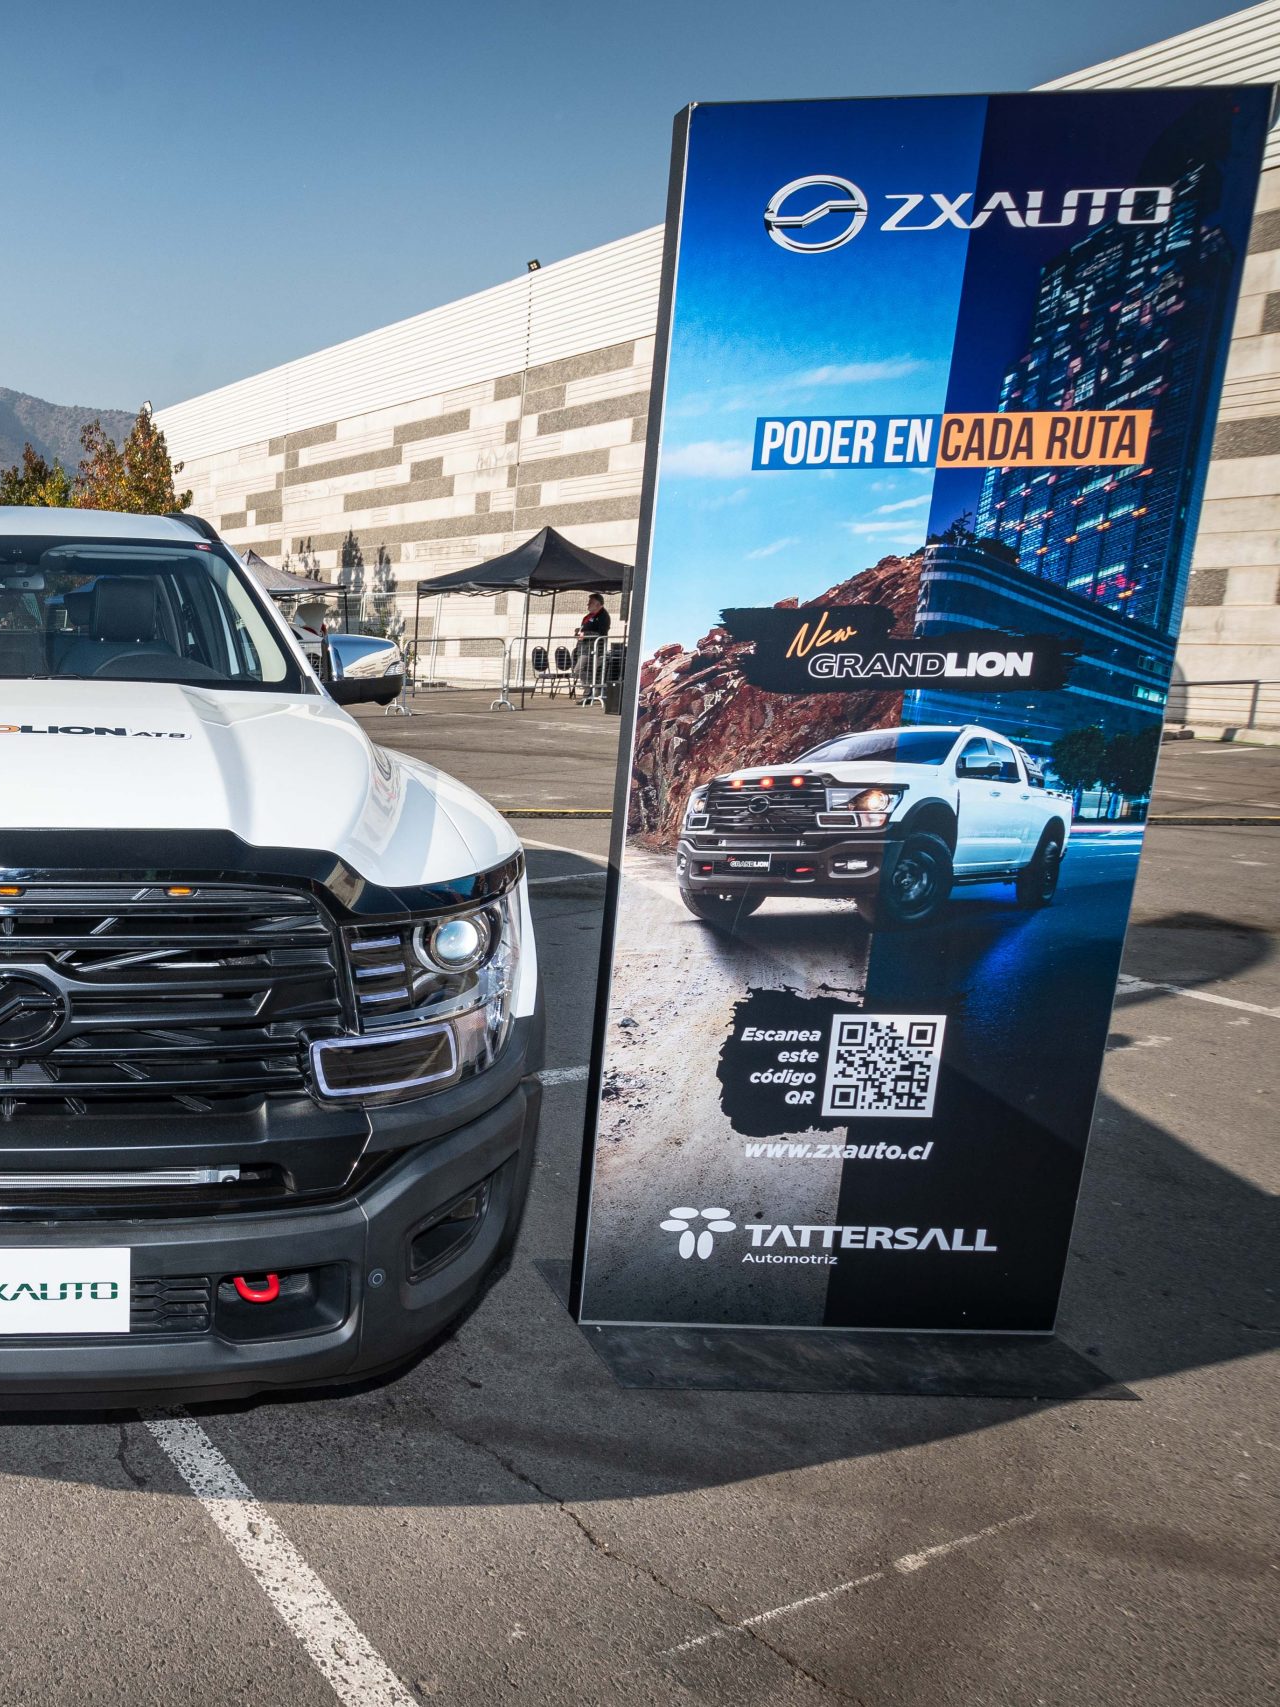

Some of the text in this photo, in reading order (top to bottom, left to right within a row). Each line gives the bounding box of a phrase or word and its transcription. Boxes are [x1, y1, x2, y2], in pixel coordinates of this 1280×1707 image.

[880, 186, 1173, 231] ZXAUTO
[761, 414, 1137, 464] PODER EN CADA RUTA
[786, 611, 857, 658] New
[808, 652, 1033, 678] GRANDLION
[741, 1027, 821, 1042] Escanea
[778, 1050, 819, 1063] este
[750, 1069, 816, 1086] código
[785, 1091, 815, 1105] QR
[744, 1141, 934, 1160] www.zxauto.cl
[745, 1224, 997, 1252] TATTERSALL
[742, 1253, 838, 1265] Automotriz
